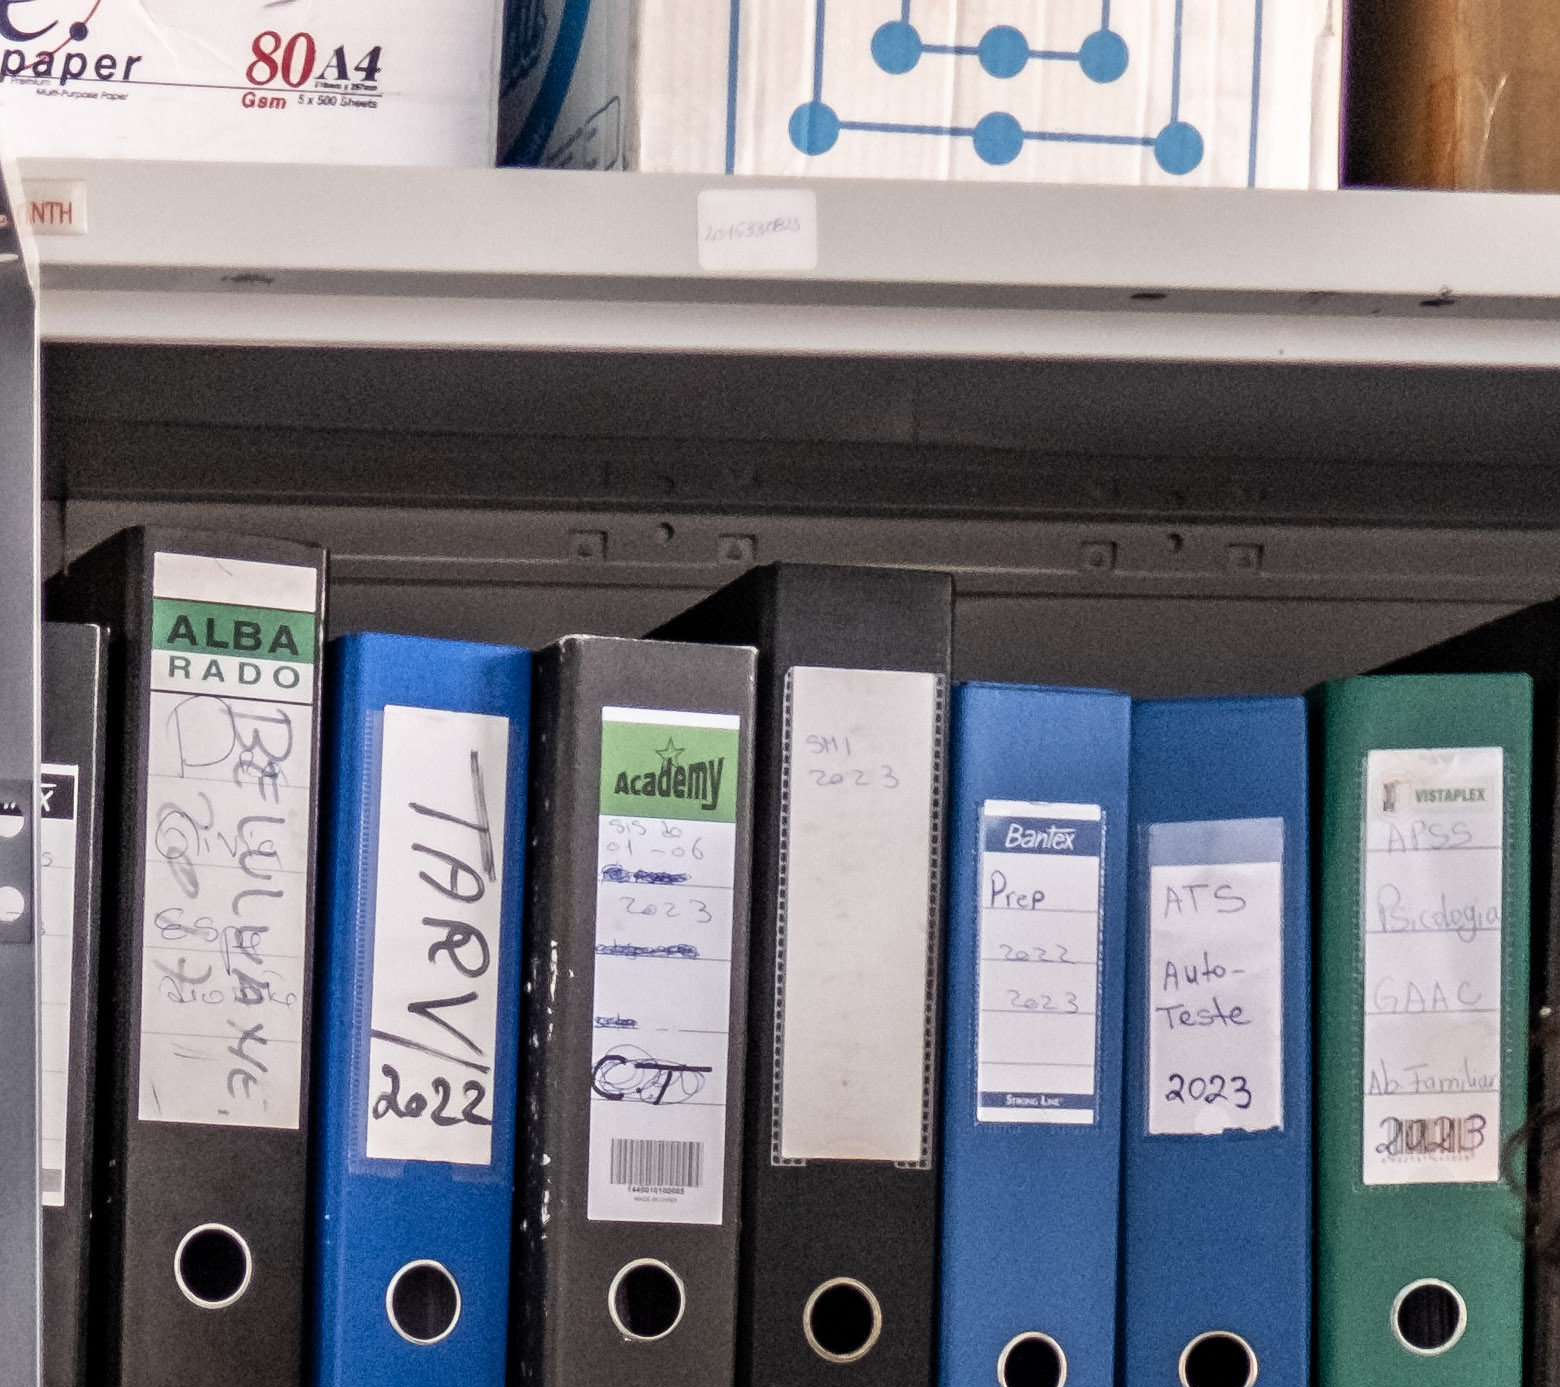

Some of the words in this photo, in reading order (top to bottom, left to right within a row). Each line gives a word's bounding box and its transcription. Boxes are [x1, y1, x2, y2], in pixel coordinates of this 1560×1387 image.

[0, 48, 142, 86] paper
[246, 30, 317, 88] 80
[315, 46, 382, 82] A4
[241, 91, 287, 110] Gsm
[166, 614, 300, 656] ALBA
[168, 655, 300, 689] RADO
[614, 756, 724, 811] Academy
[808, 764, 900, 788] 2023
[1415, 787, 1487, 802] VISTAPLEX
[1004, 823, 1076, 851] Bantex
[1388, 818, 1473, 854] APSS
[619, 896, 712, 923] 2023
[1164, 883, 1246, 919] ATS
[999, 943, 1075, 965] 2022
[1007, 988, 1079, 1015] 2023
[1374, 975, 1483, 1013] GAAC
[1156, 996, 1251, 1030] Teste
[372, 1063, 493, 1127] 2022
[1165, 1072, 1252, 1109] 2023
[1375, 1113, 1488, 1156] 2023
